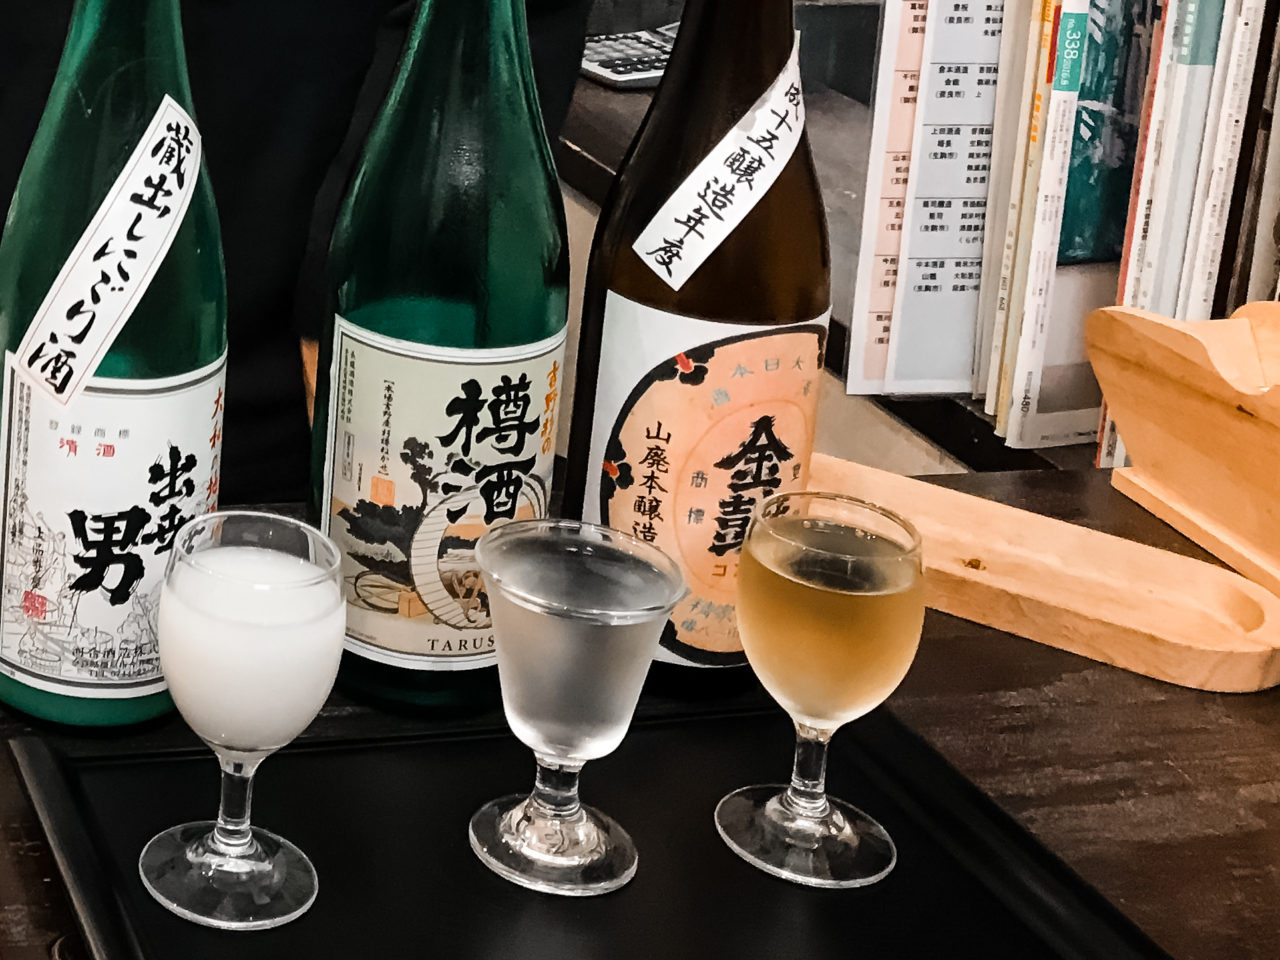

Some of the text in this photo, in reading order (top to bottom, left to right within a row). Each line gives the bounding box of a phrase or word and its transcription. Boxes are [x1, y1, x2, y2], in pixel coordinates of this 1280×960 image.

[27, 121, 194, 394] 蔵出しにごり酒
[59, 437, 116, 458] 清酒
[435, 373, 541, 526] 樽酒
[632, 420, 672, 543] 山廃本醸造
[427, 634, 496, 651] TARUS
